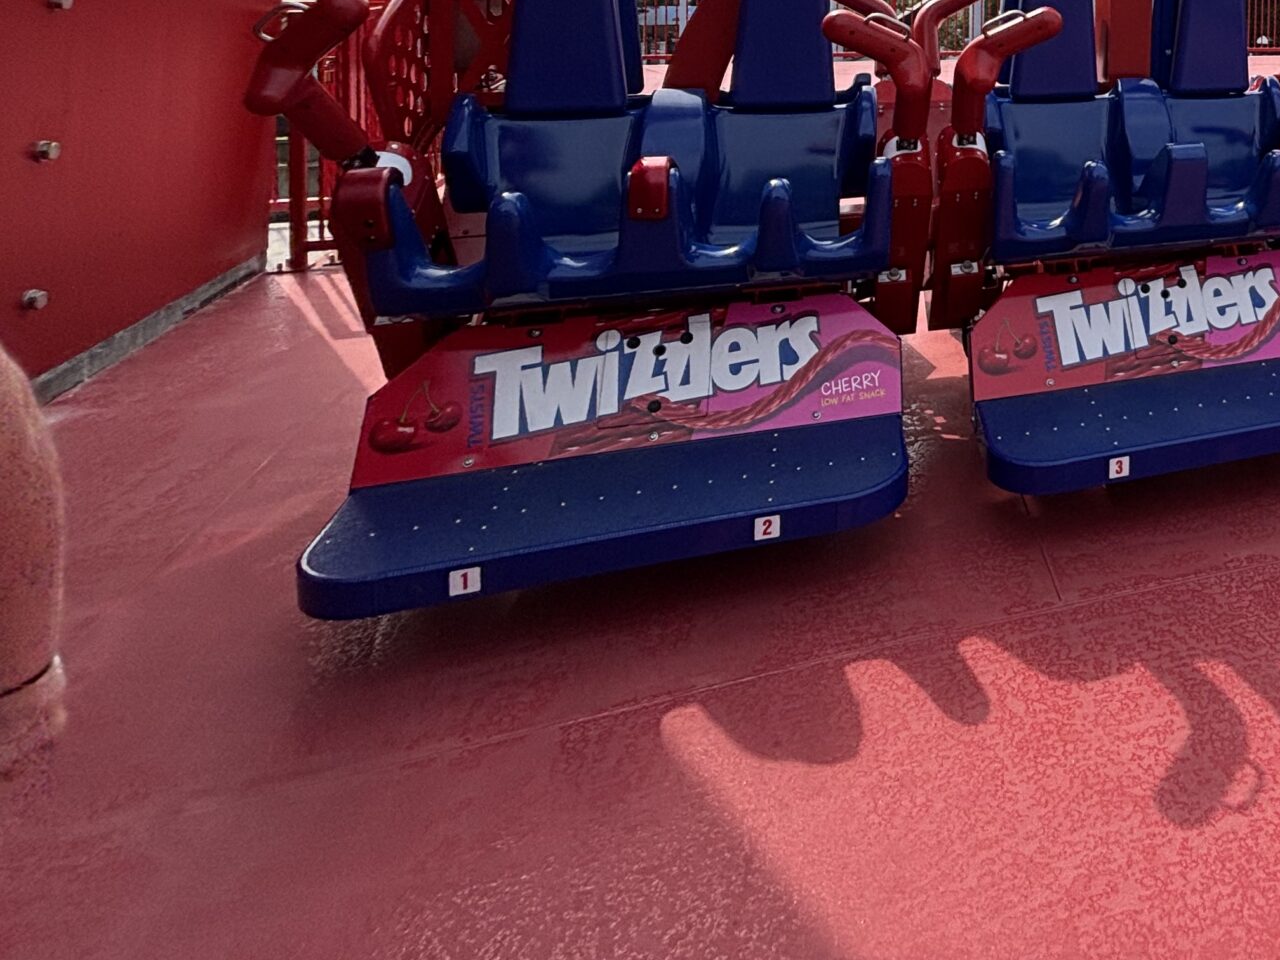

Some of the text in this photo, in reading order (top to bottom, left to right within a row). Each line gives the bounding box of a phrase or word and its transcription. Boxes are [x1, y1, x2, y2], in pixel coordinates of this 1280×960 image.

[1035, 265, 1280, 366] Twizzlers
[473, 313, 819, 440] Twizzlers
[821, 369, 880, 396] CHERRY
[1115, 460, 1123, 475] 3
[762, 519, 773, 536] 2
[460, 572, 469, 590] 1
